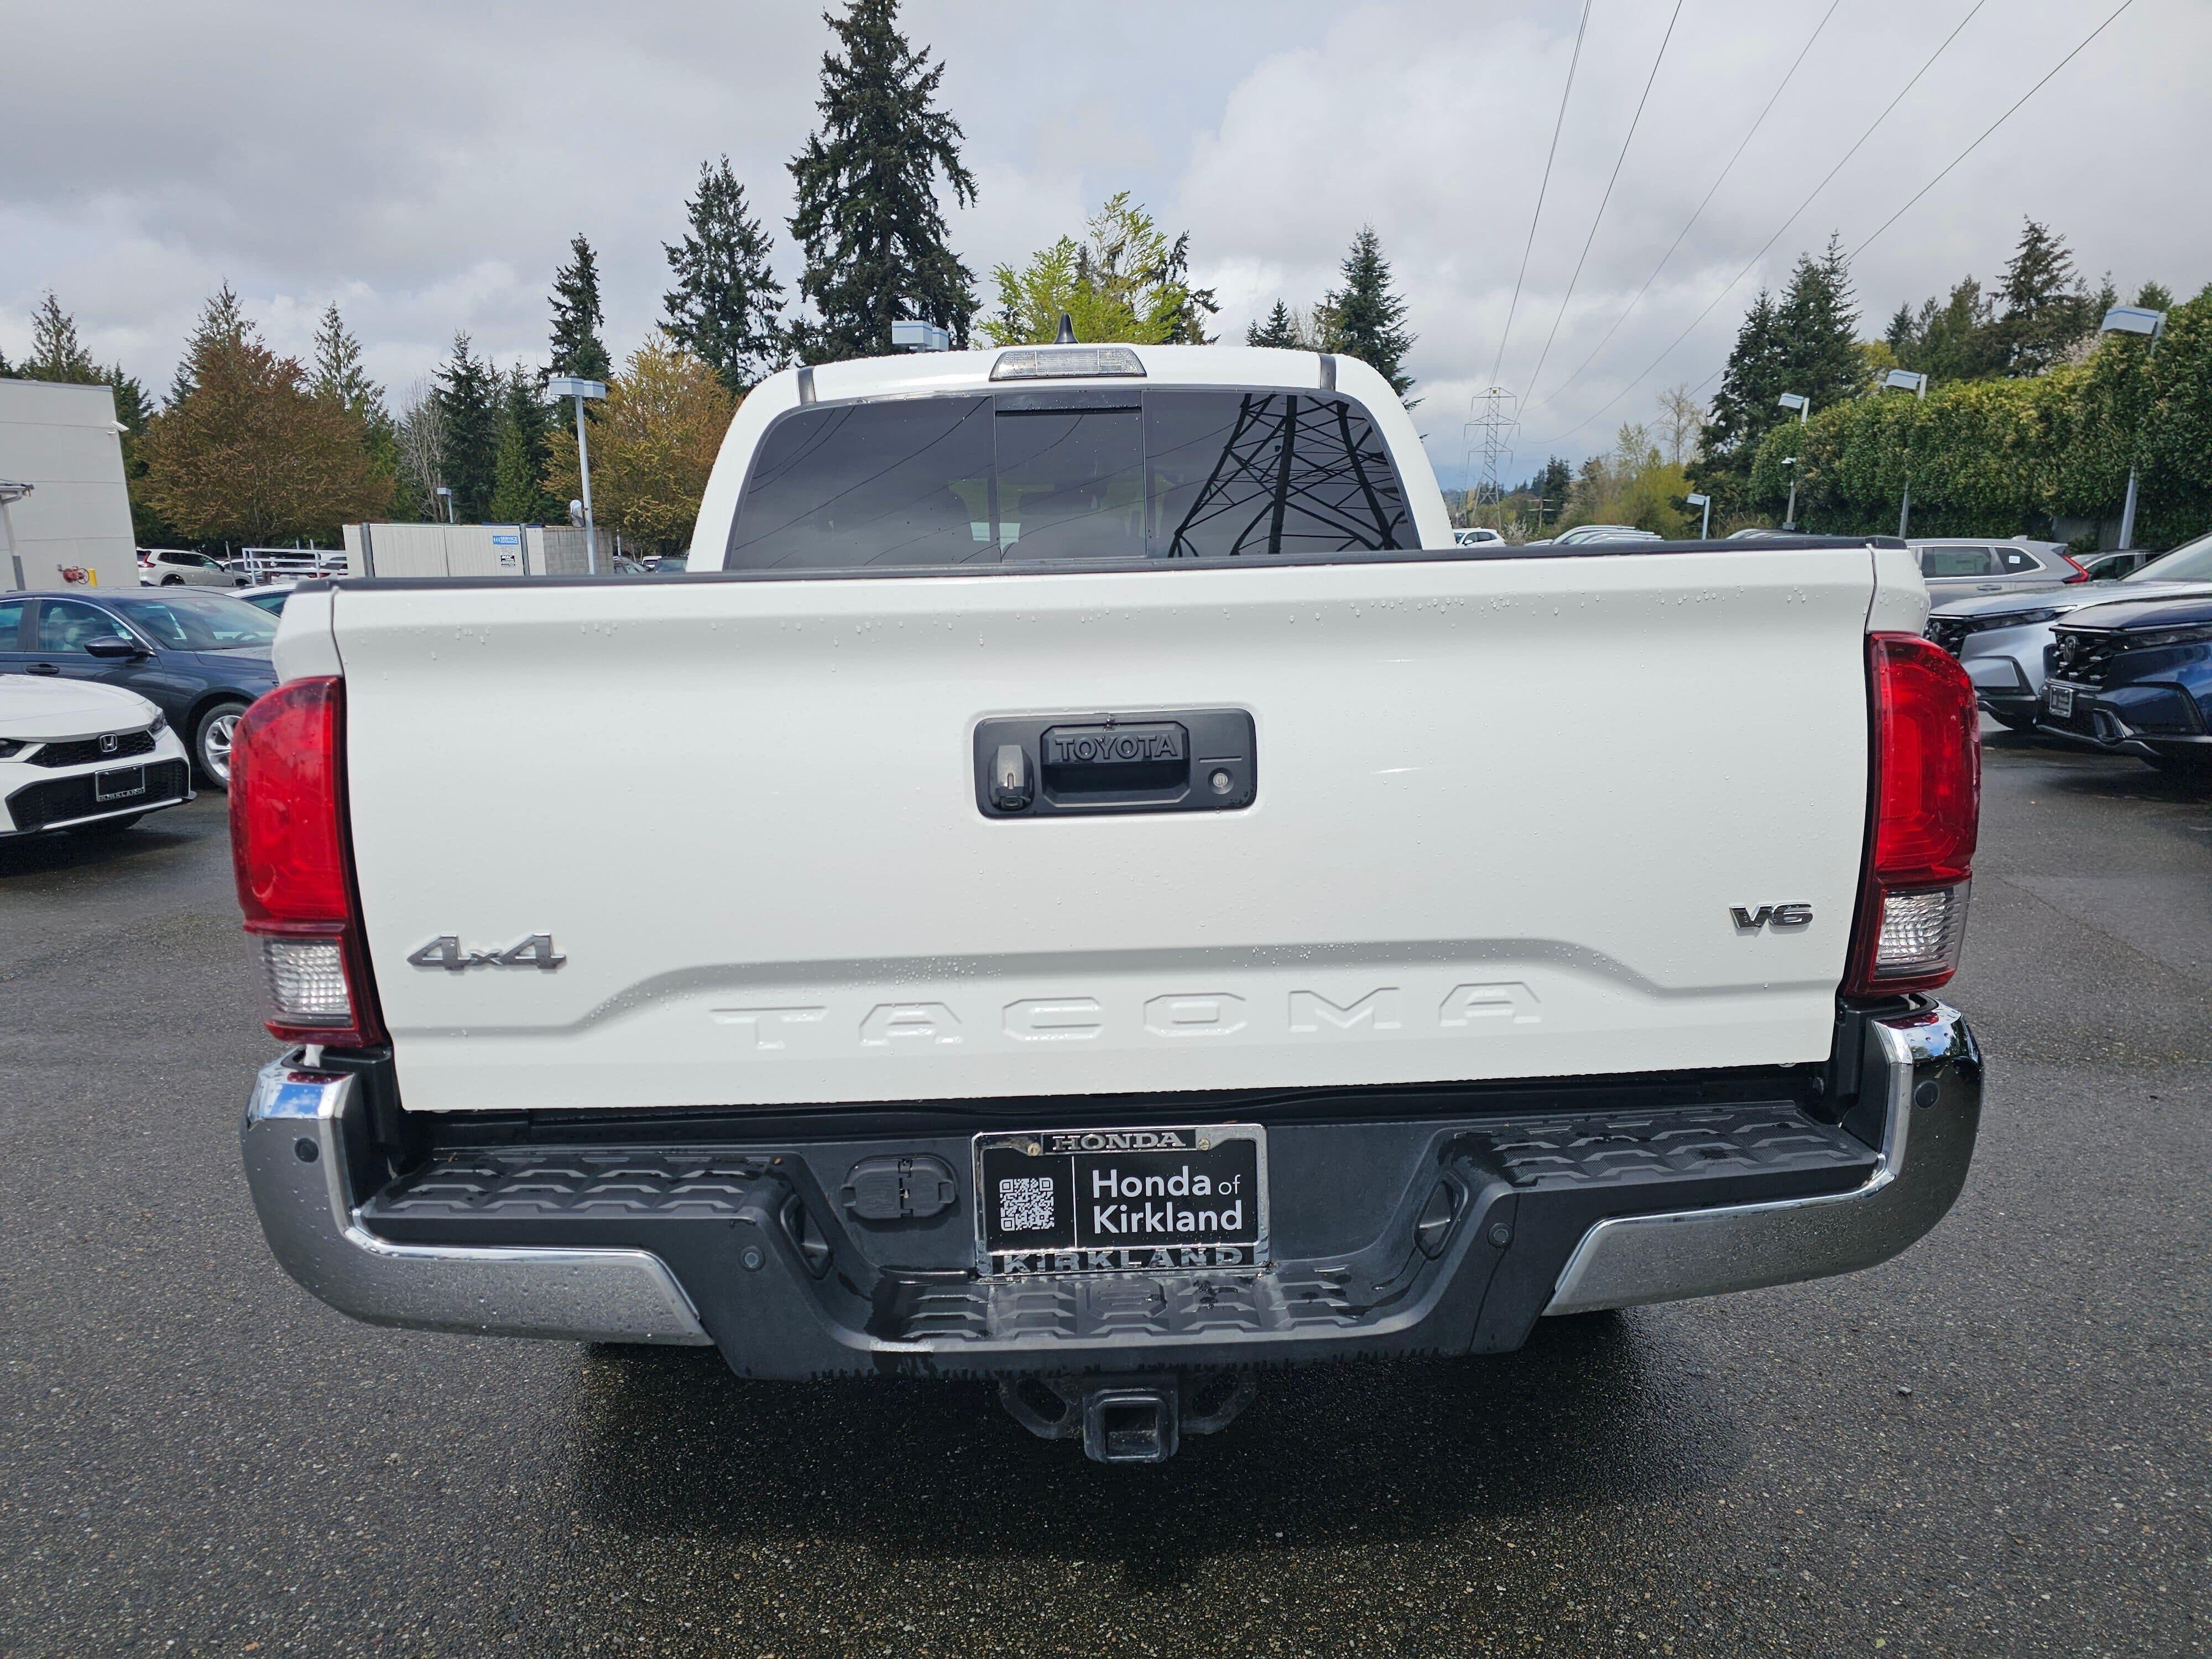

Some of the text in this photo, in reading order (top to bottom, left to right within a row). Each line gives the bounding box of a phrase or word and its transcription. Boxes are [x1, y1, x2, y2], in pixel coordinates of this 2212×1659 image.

[1055, 734, 1179, 761] TOYOTA
[1729, 902, 1813, 928] V6
[406, 933, 567, 971] 4x4
[708, 982, 1543, 1050] TACOMA
[1052, 1132, 1186, 1151] HONDA
[1092, 1165, 1240, 1198] Honda of
[1093, 1200, 1242, 1234] Kirkland
[1003, 1248, 1244, 1274] KIRKLAND
